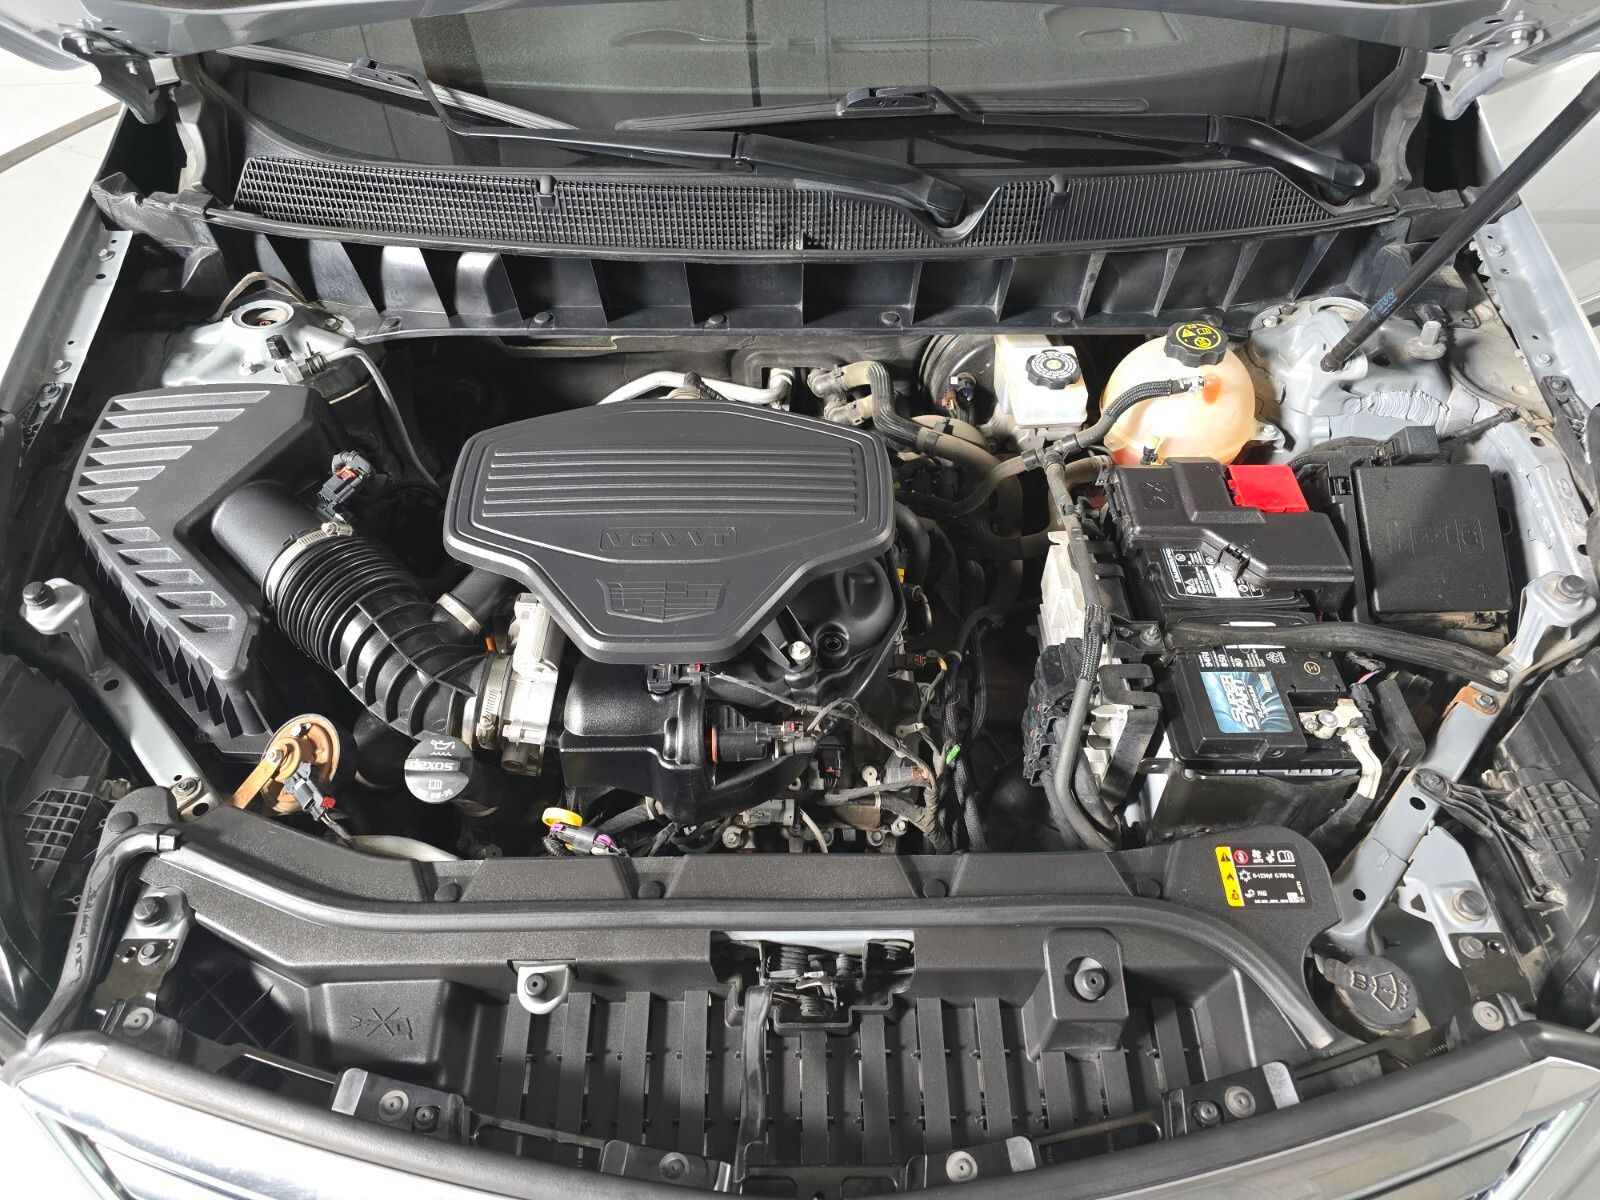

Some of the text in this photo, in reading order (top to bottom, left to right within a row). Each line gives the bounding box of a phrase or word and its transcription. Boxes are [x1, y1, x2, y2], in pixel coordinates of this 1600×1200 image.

[1220, 674, 1242, 722] SUPER
[1234, 679, 1260, 730] START
[408, 758, 456, 771] dexos
